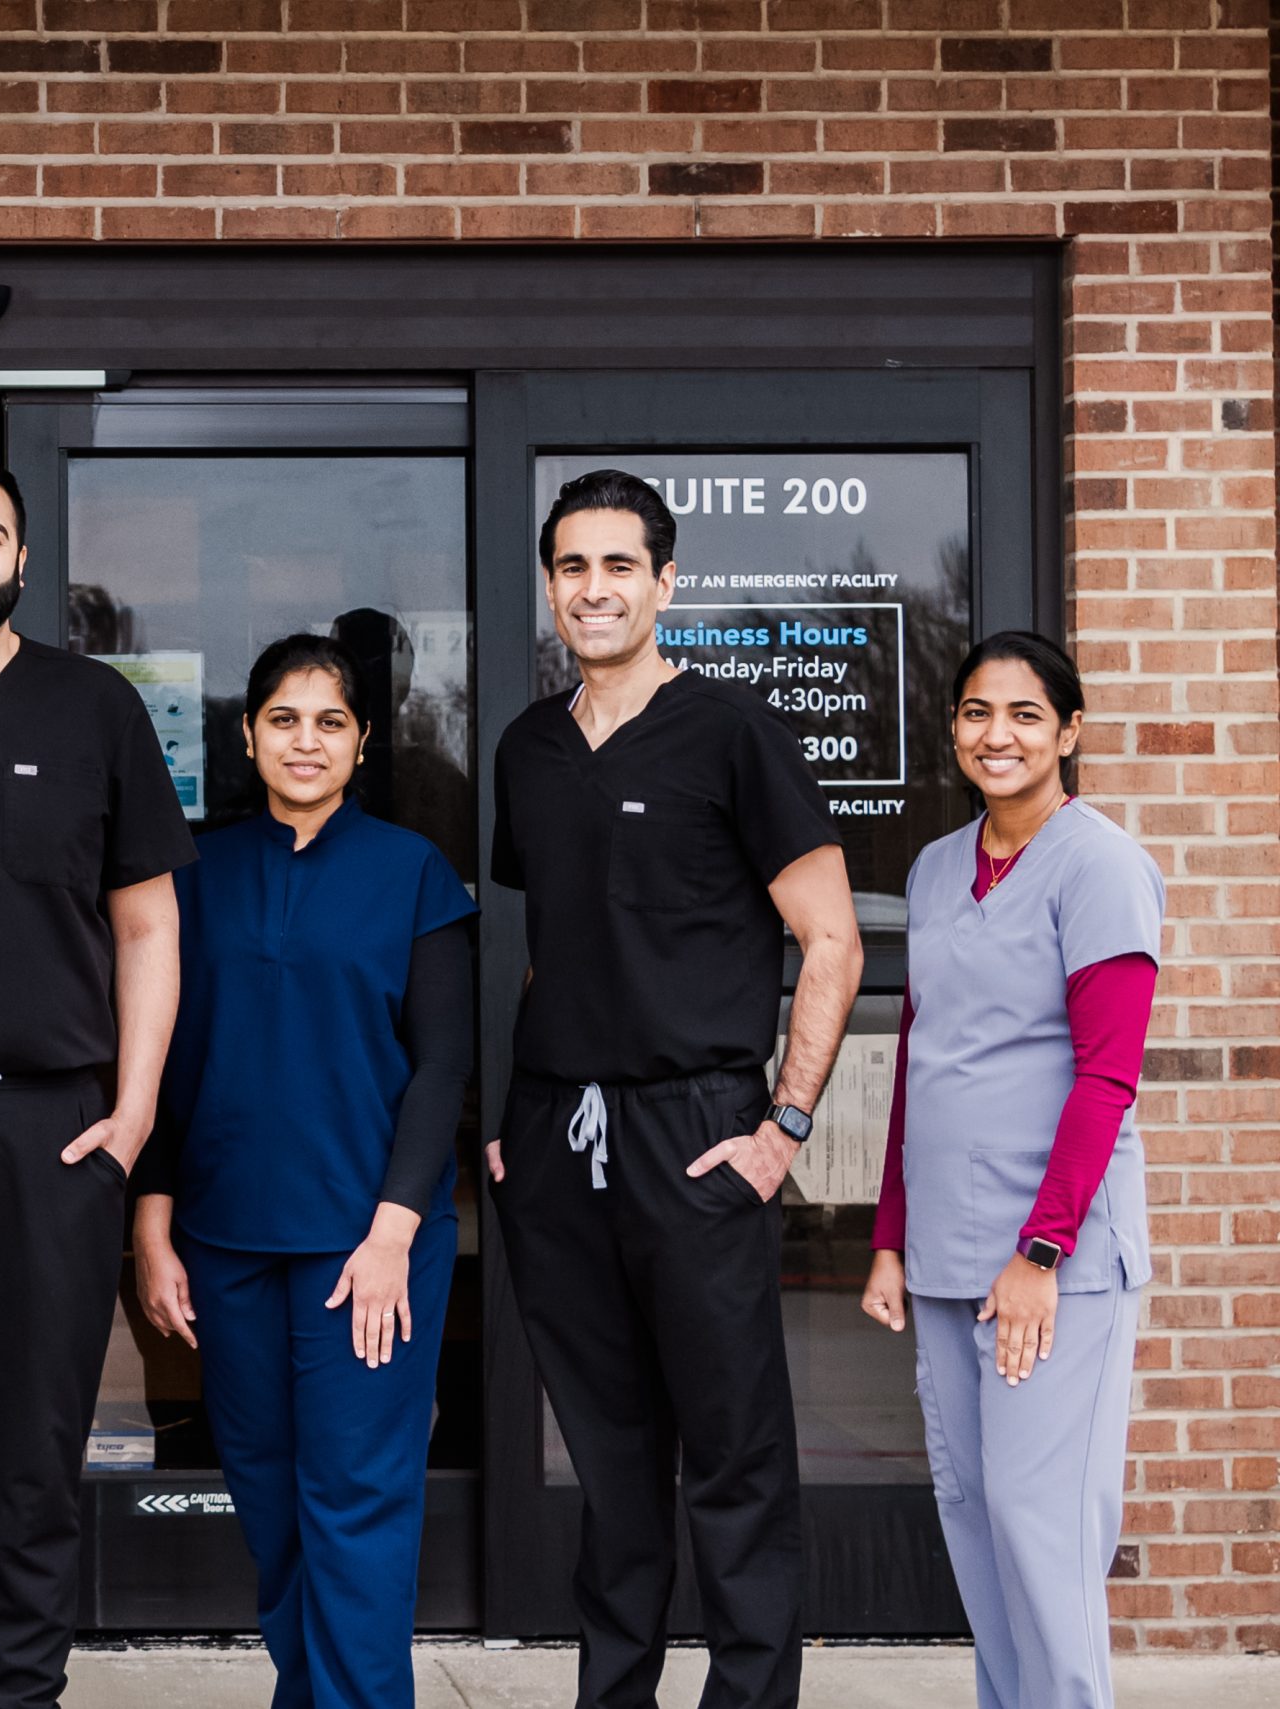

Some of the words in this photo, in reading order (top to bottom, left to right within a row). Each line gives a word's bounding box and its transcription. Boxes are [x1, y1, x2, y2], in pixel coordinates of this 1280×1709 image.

[783, 478, 867, 514] 200
[673, 575, 697, 588] OT
[701, 575, 726, 588] AN
[730, 574, 828, 588] EMERGENCY
[832, 573, 898, 588] FACILITY
[780, 621, 868, 646] Hours
[767, 688, 867, 718] 4:30pm
[829, 800, 905, 815] FACILITY
[203, 1502, 225, 1513] Door
